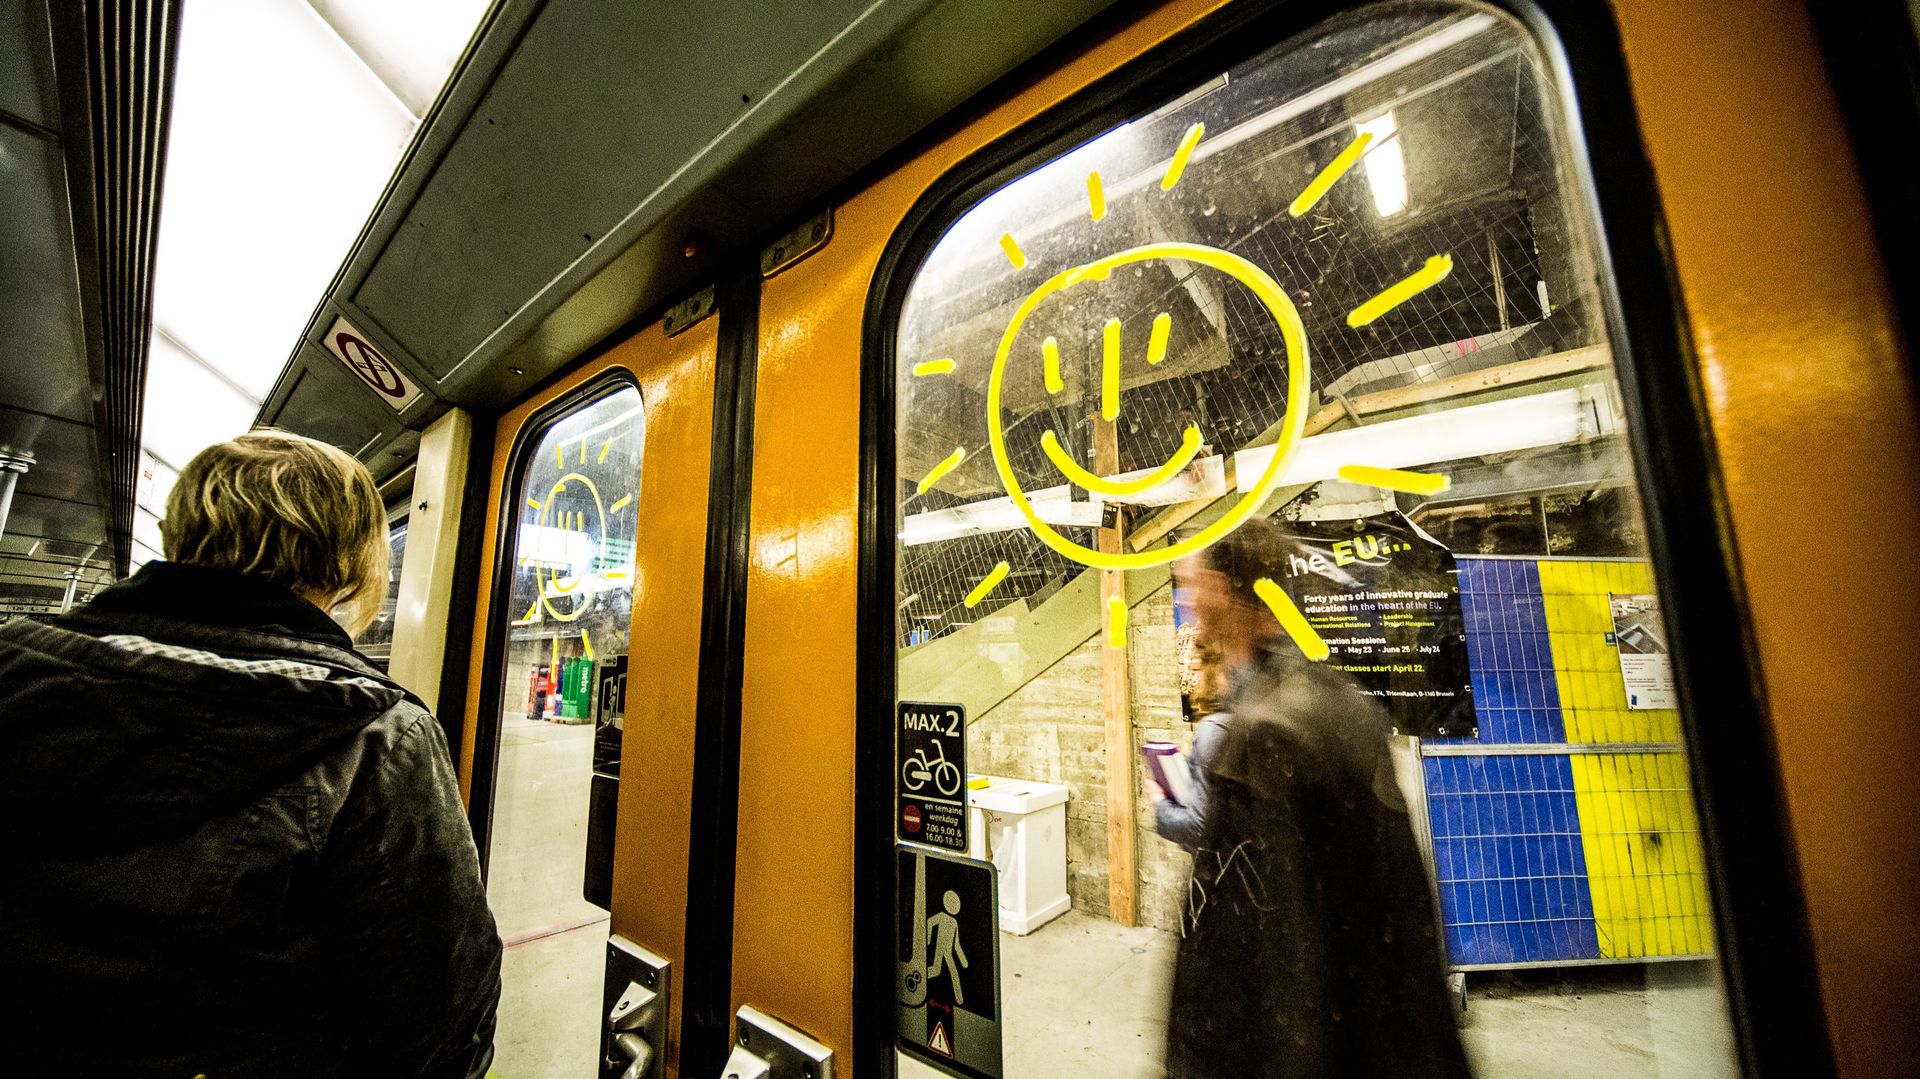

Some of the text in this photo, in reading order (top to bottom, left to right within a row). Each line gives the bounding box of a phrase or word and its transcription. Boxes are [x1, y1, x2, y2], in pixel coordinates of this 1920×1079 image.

[1304, 590, 1448, 604] Forty years of innovative graduate
[1305, 601, 1442, 613] education in the heart of the EU.
[1351, 636, 1386, 645] Sessions
[1347, 646, 1362, 654] May
[1382, 645, 1400, 654] June
[1419, 645, 1432, 654] July
[1393, 664, 1413, 673] April
[1413, 664, 1425, 672] 22.
[580, 667, 589, 693] metro
[924, 803, 963, 816] en semaine
[929, 813, 959, 827] weekdag
[956, 828, 963, 838] &
